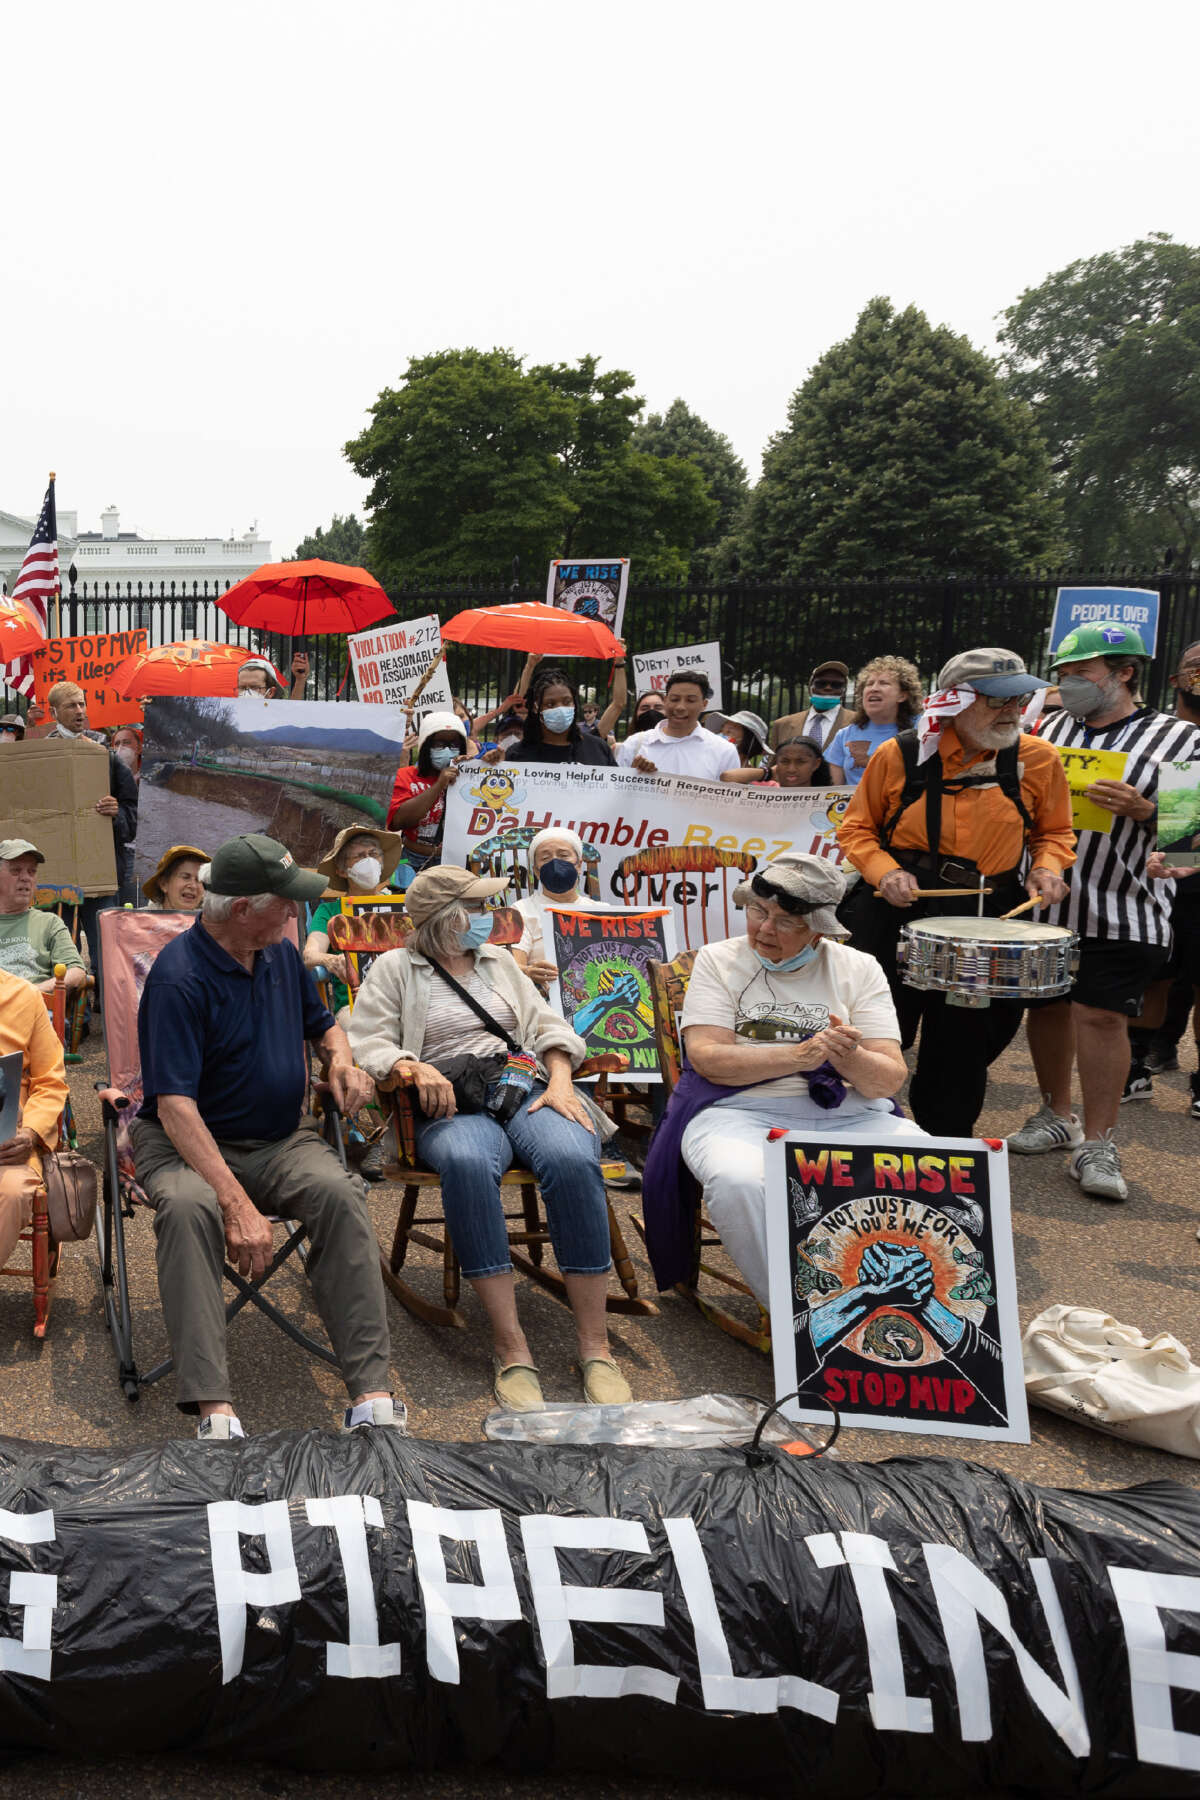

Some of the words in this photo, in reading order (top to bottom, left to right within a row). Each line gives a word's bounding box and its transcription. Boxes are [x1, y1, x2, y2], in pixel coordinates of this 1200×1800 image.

[560, 566, 579, 579] WE
[586, 565, 620, 580] RISE
[1071, 604, 1121, 622] PEOPLE
[1123, 605, 1149, 623] OVER
[354, 630, 407, 659] VIOLATION
[358, 661, 380, 689] NO
[380, 648, 440, 672] REASONABLE
[635, 658, 670, 673] DIRTY
[677, 655, 705, 667] DEAL
[385, 686, 408, 701] PAST
[457, 764, 481, 775] Kind
[525, 768, 561, 781] Loving
[566, 768, 604, 782] Helpful
[611, 772, 671, 788] Successful
[677, 780, 742, 798] Respectful
[747, 791, 820, 803] Empowered
[557, 913, 592, 937] WE
[601, 917, 658, 938] RISE
[576, 948, 592, 966] NOT
[601, 944, 623, 953] JUST
[589, 954, 609, 967] YOU
[634, 1047, 660, 1068] MV
[794, 1148, 854, 1188] WE
[873, 1152, 976, 1194] RISE
[821, 1203, 856, 1235] NOT
[864, 1198, 911, 1217] JUST
[922, 1206, 962, 1245] FOR
[848, 1217, 882, 1239] YOU
[886, 1216, 897, 1230] &
[903, 1219, 930, 1240] ME
[823, 1367, 906, 1408] STOP
[910, 1374, 977, 1414] MVP
[207, 1496, 1200, 1770] PIPELINE
